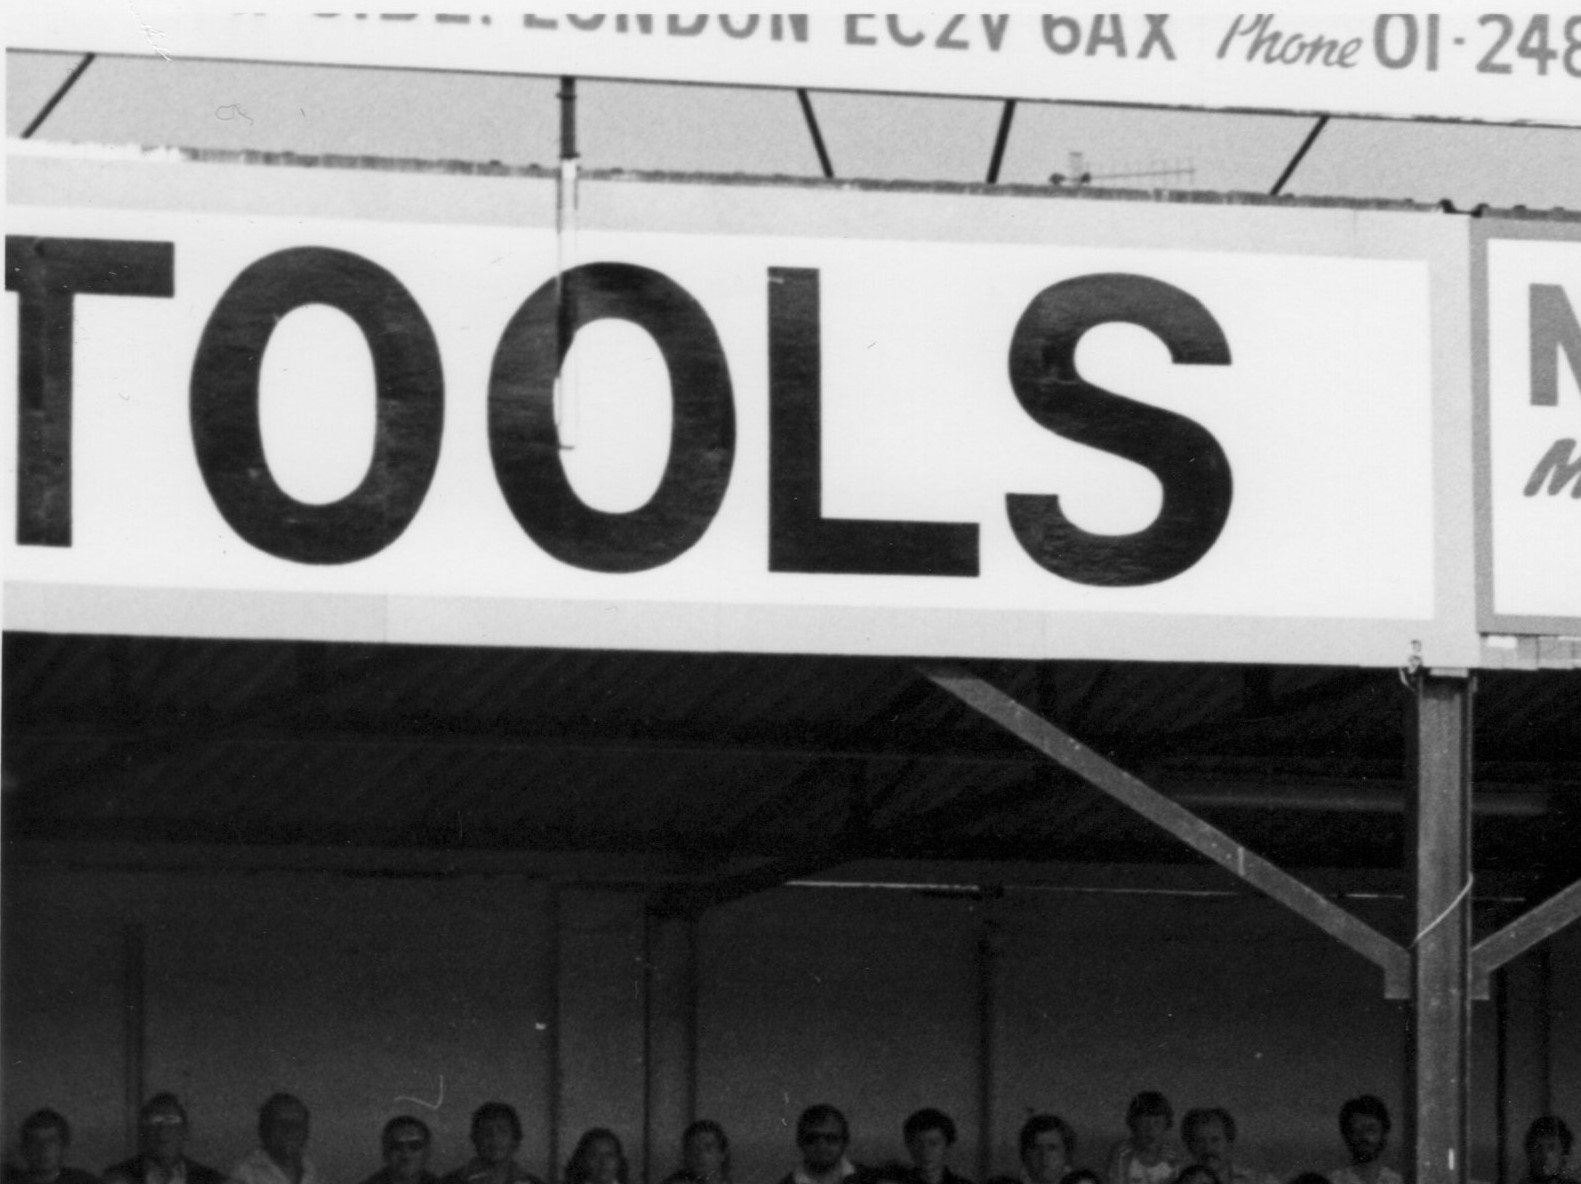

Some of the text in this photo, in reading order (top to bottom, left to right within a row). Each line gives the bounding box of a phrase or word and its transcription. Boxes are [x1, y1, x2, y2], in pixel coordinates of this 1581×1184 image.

[1042, 14, 1175, 60] 6AX
[1217, 14, 1362, 68] Phone
[5, 236, 1233, 587] TOOLS
